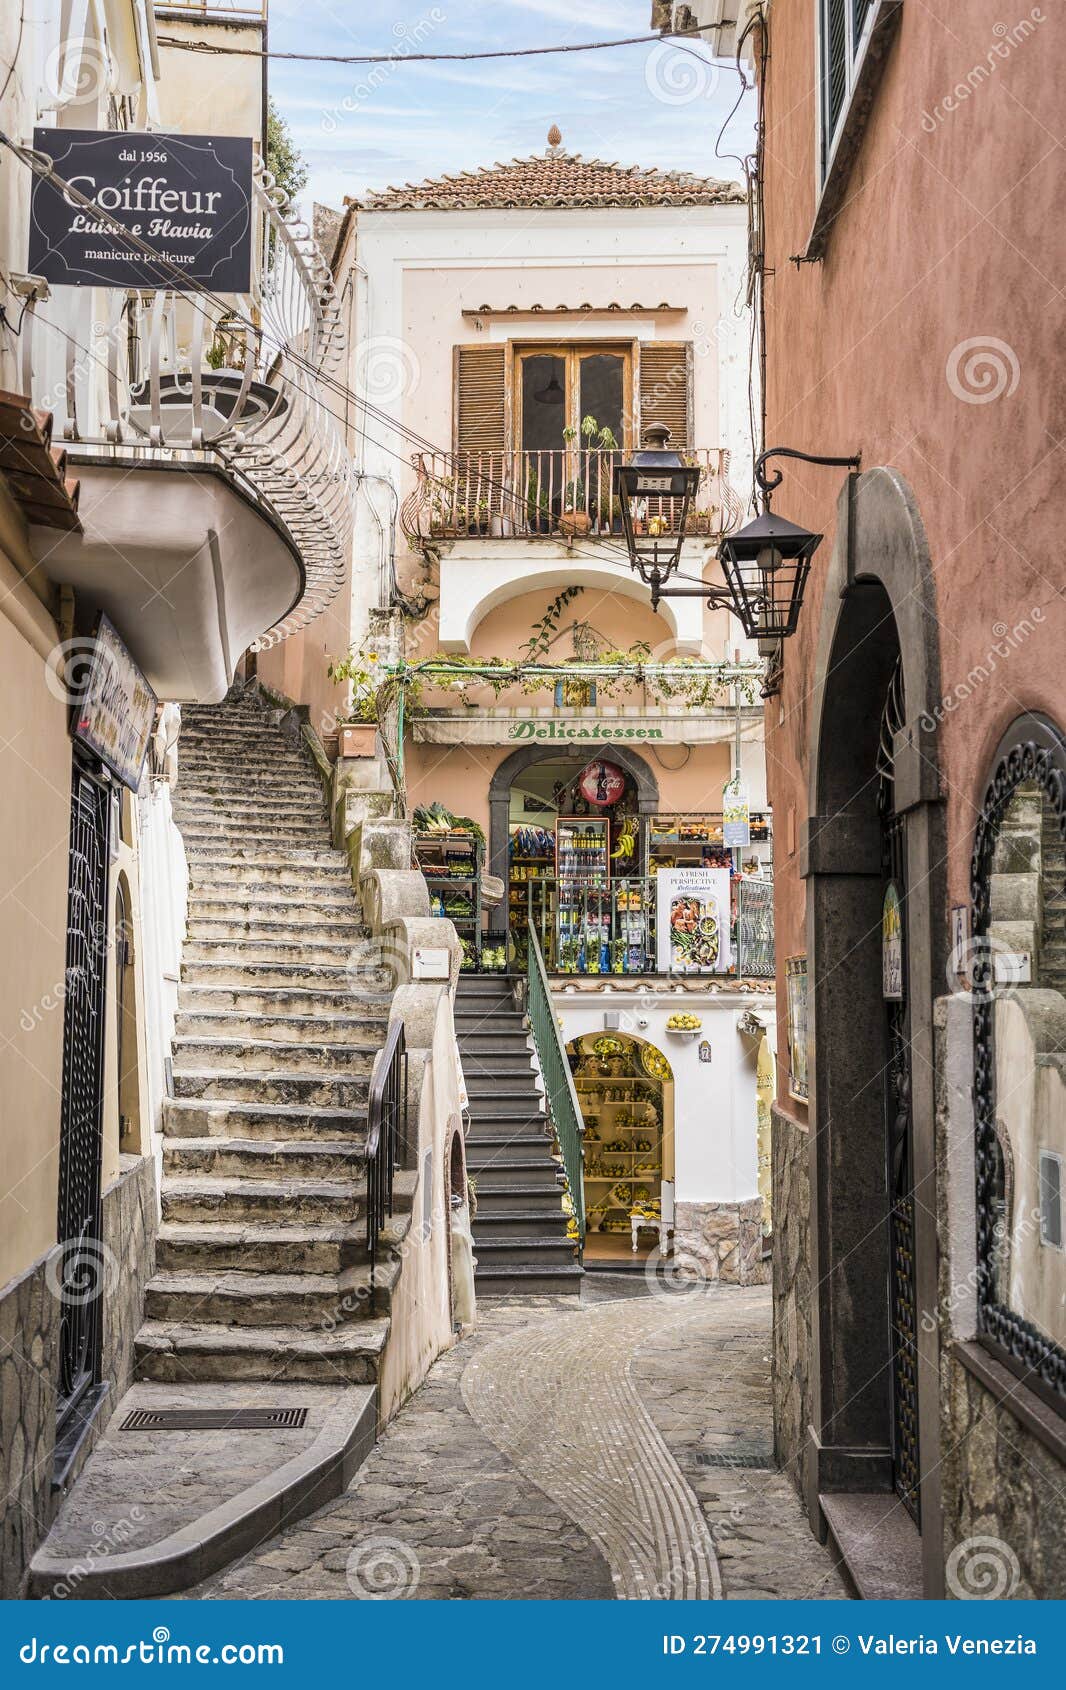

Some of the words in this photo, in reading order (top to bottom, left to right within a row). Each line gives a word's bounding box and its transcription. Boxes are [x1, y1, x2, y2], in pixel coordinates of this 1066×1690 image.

[118, 149, 137, 162] dal
[140, 150, 168, 164] 1956
[63, 175, 222, 215] Coiffeur
[131, 223, 143, 236] e
[147, 218, 214, 241] Flavia
[84, 248, 141, 263] manicure
[508, 720, 664, 739] Delicatessen
